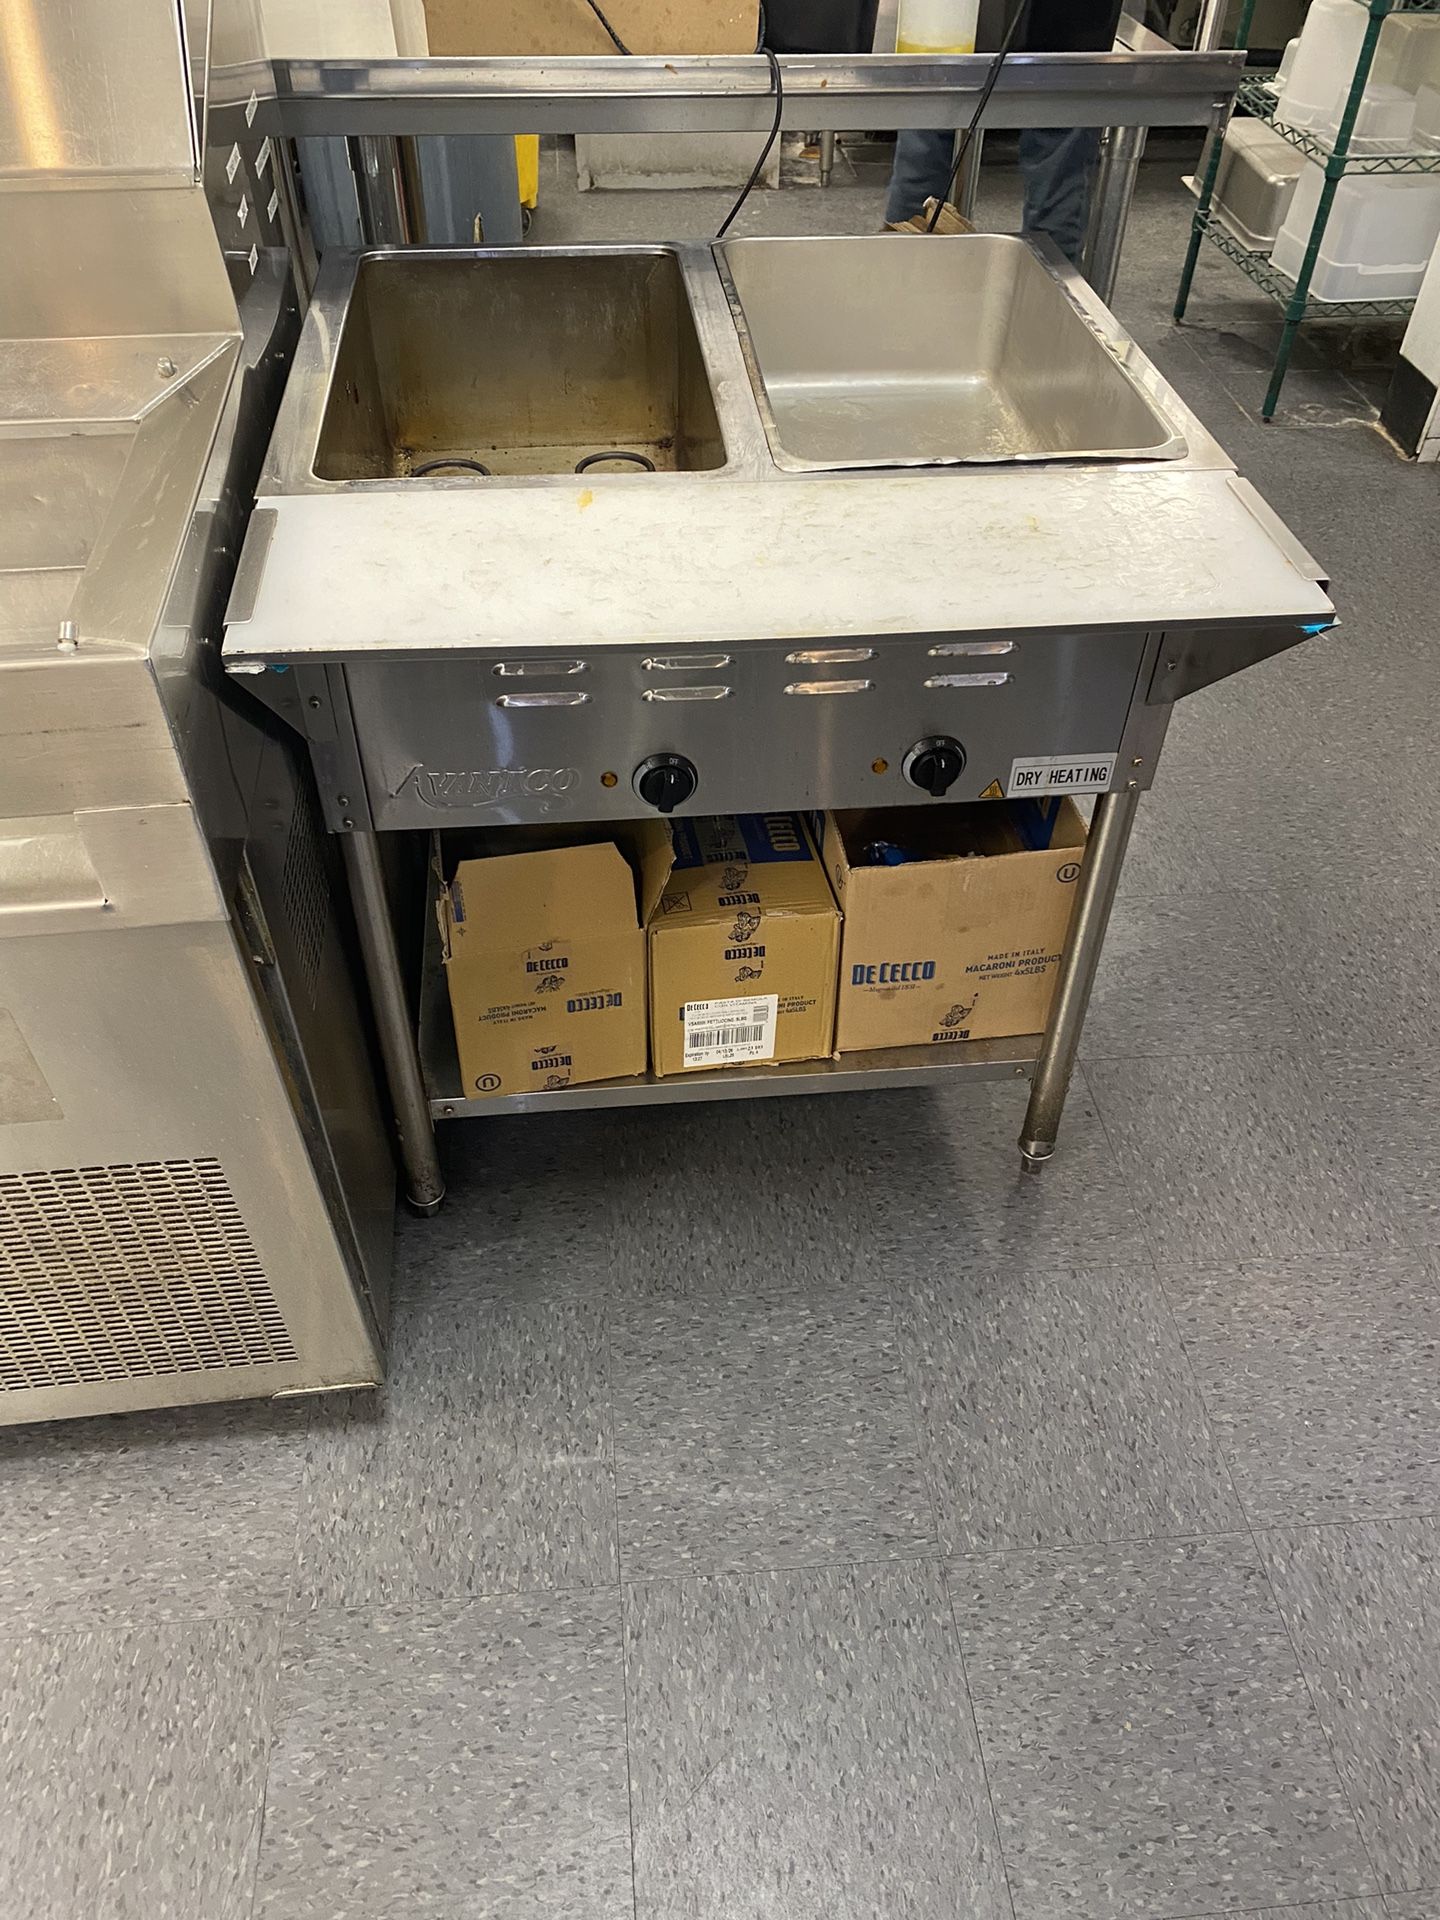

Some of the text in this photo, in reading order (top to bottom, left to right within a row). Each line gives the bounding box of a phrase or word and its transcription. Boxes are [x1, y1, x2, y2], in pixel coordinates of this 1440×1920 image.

[669, 758, 679, 766] OFF
[1016, 766, 1108, 786] DRY HEATING
[718, 894, 748, 907] CECCO
[724, 947, 752, 960] CECCO
[988, 952, 1008, 960] MADE
[1022, 948, 1046, 956] ITALY
[540, 958, 568, 971] CECCO
[965, 954, 1062, 973] MACARONI PRODUCT
[878, 960, 936, 984] CECCO
[567, 995, 605, 1013] CECCO
[786, 1000, 816, 1008] PRODUCT
[478, 1006, 546, 1022] MACARONI PRODUCT
[532, 1058, 559, 1070] CECCO
